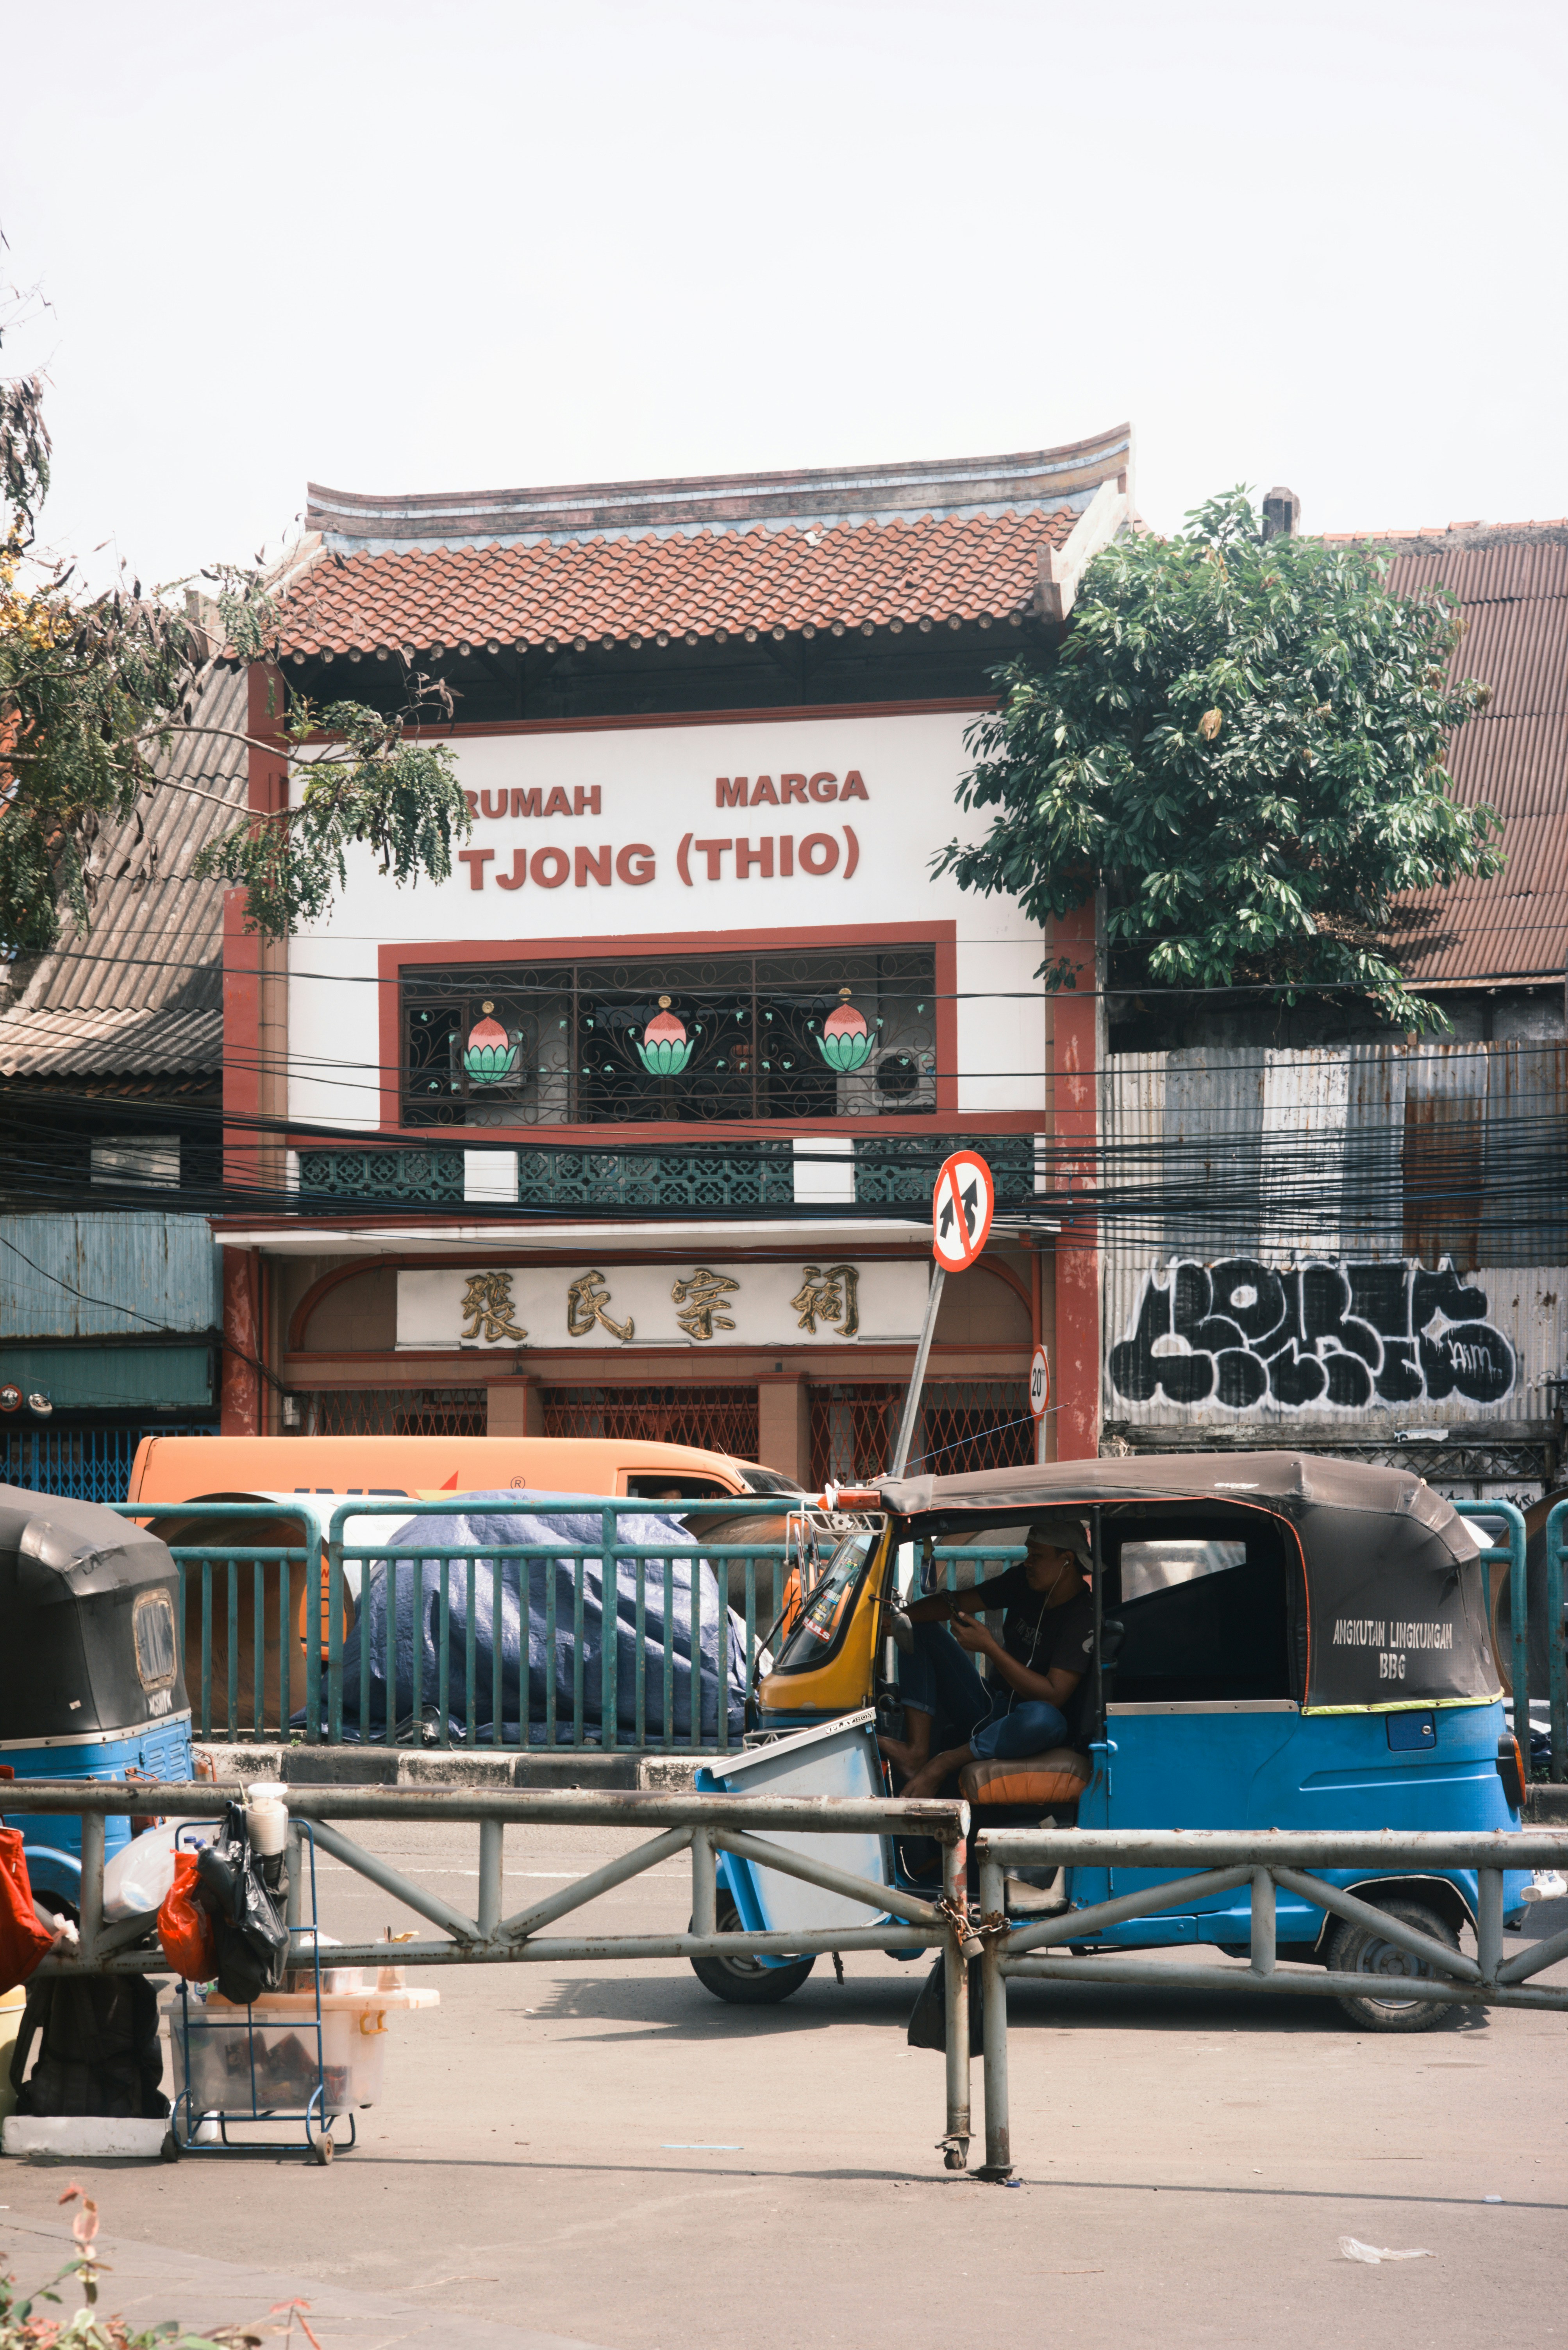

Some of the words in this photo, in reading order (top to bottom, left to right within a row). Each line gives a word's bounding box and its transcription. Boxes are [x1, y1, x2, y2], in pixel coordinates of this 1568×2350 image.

[461, 785, 601, 819] RUMAH
[716, 770, 869, 807] MARGA
[459, 844, 655, 891] TJONG
[677, 825, 860, 886] (THIO)
[1032, 1368, 1041, 1397] 20
[1333, 1619, 1385, 1646] ANGKUTAN
[1390, 1622, 1452, 1649] LINGKUNGAN
[1379, 1653, 1406, 1679] BBG
